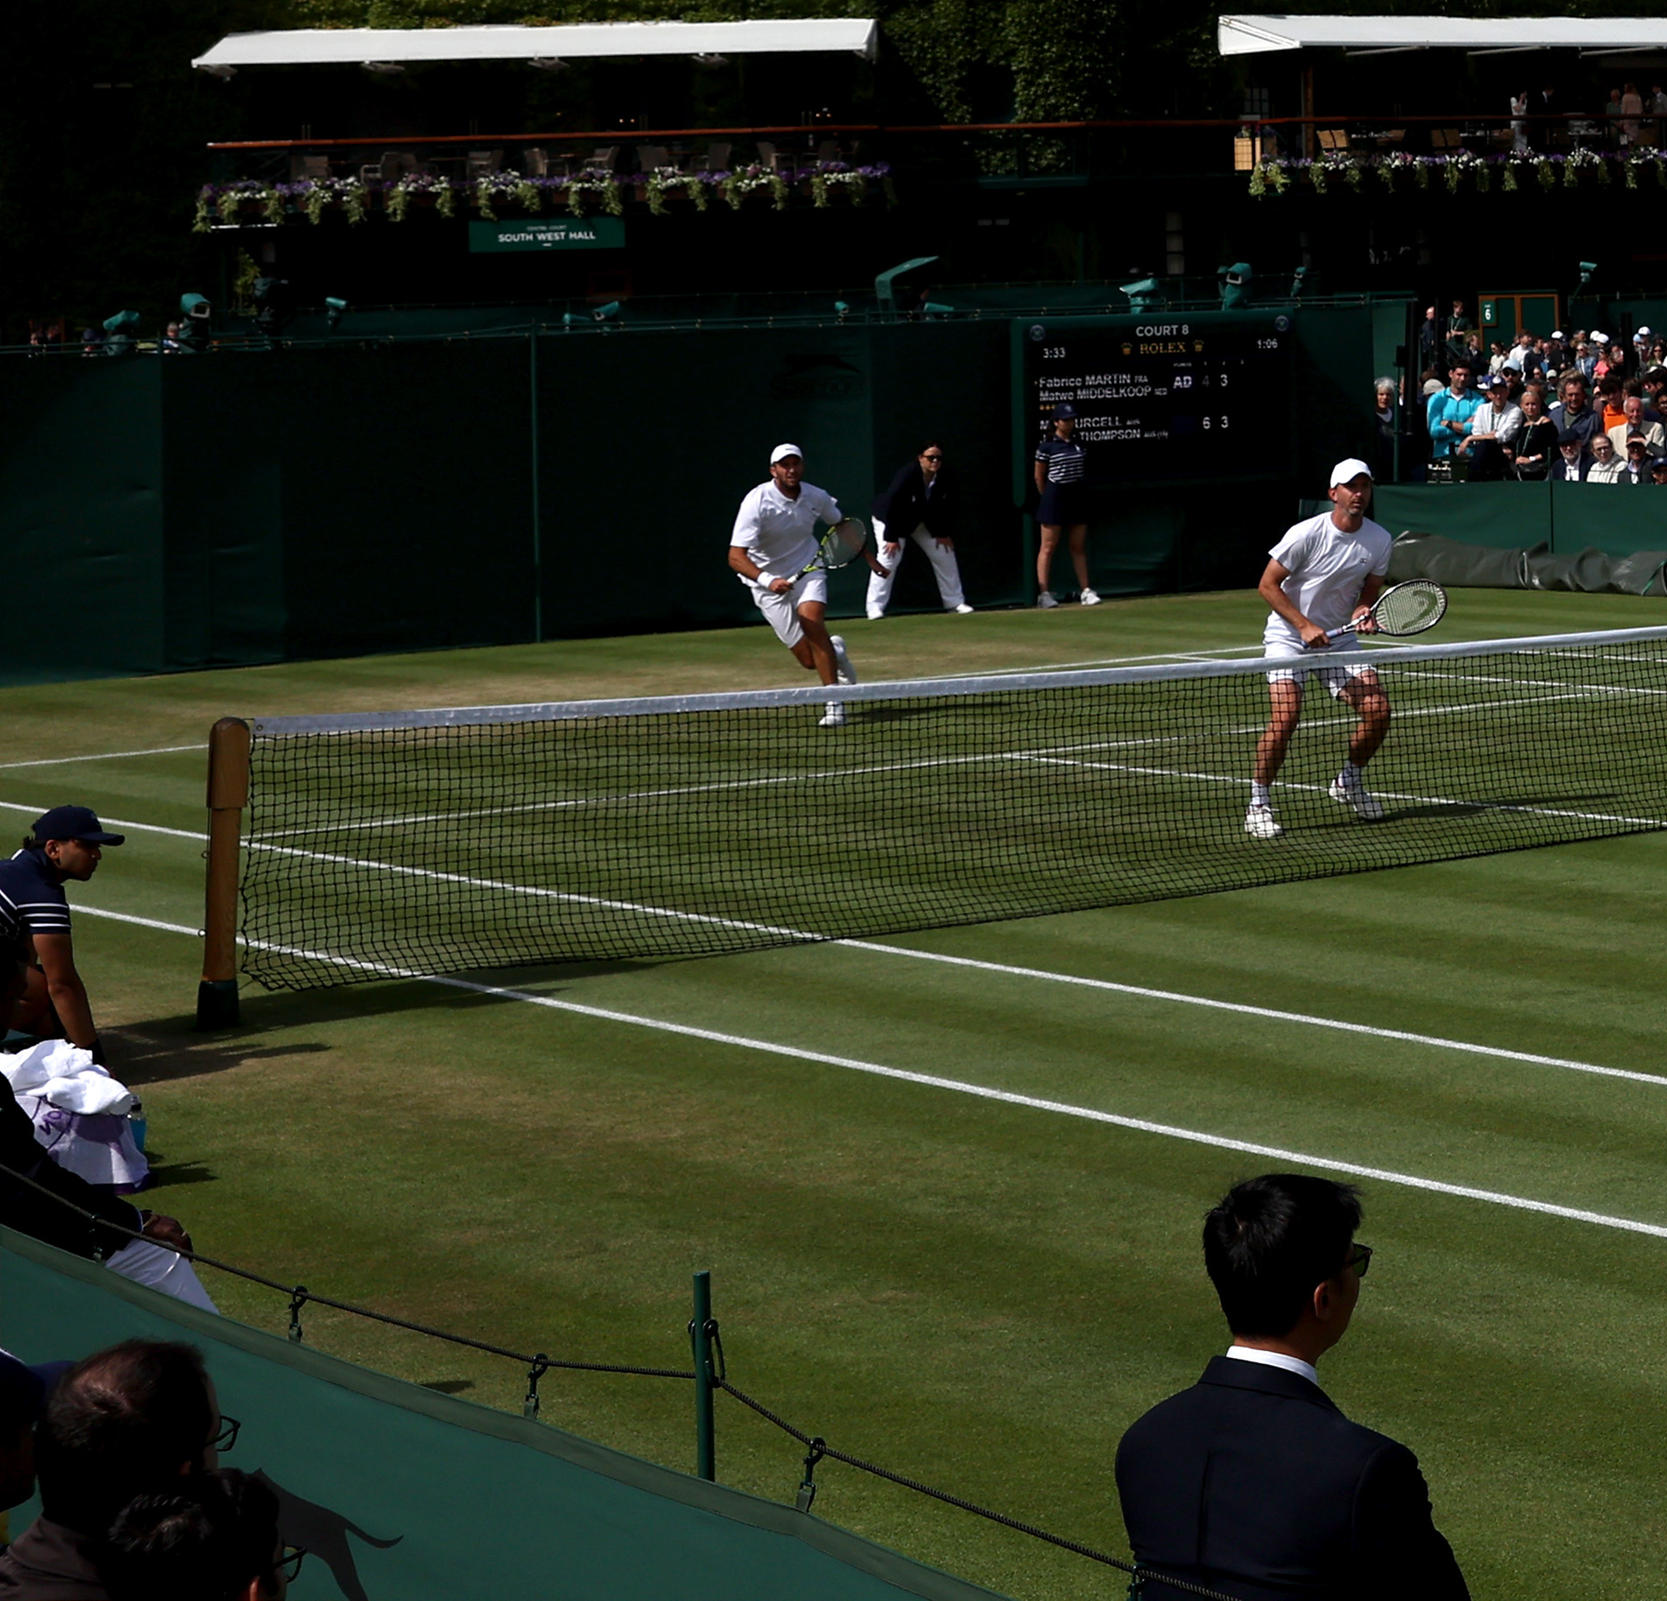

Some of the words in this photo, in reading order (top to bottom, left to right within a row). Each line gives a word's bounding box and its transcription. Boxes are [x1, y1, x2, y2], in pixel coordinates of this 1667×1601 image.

[497, 232, 533, 243] SOUTH
[535, 231, 566, 242] WEST
[568, 230, 597, 241] HALL
[1135, 325, 1179, 337] COURT
[1181, 324, 1190, 334] 8
[1139, 341, 1187, 355] ROLEX
[1256, 337, 1279, 350] 1:06
[1042, 347, 1067, 359] 3:33
[1038, 376, 1083, 388] Fabrice
[1084, 373, 1131, 387] MARTIN
[1172, 375, 1193, 389] AD
[1220, 373, 1229, 387] 3
[1076, 385, 1152, 400] MIDDELKOOP
[1074, 416, 1122, 429] URCELL
[1202, 416, 1211, 430] 6
[1220, 415, 1229, 429] 3
[1080, 429, 1141, 442] THOMPSON
